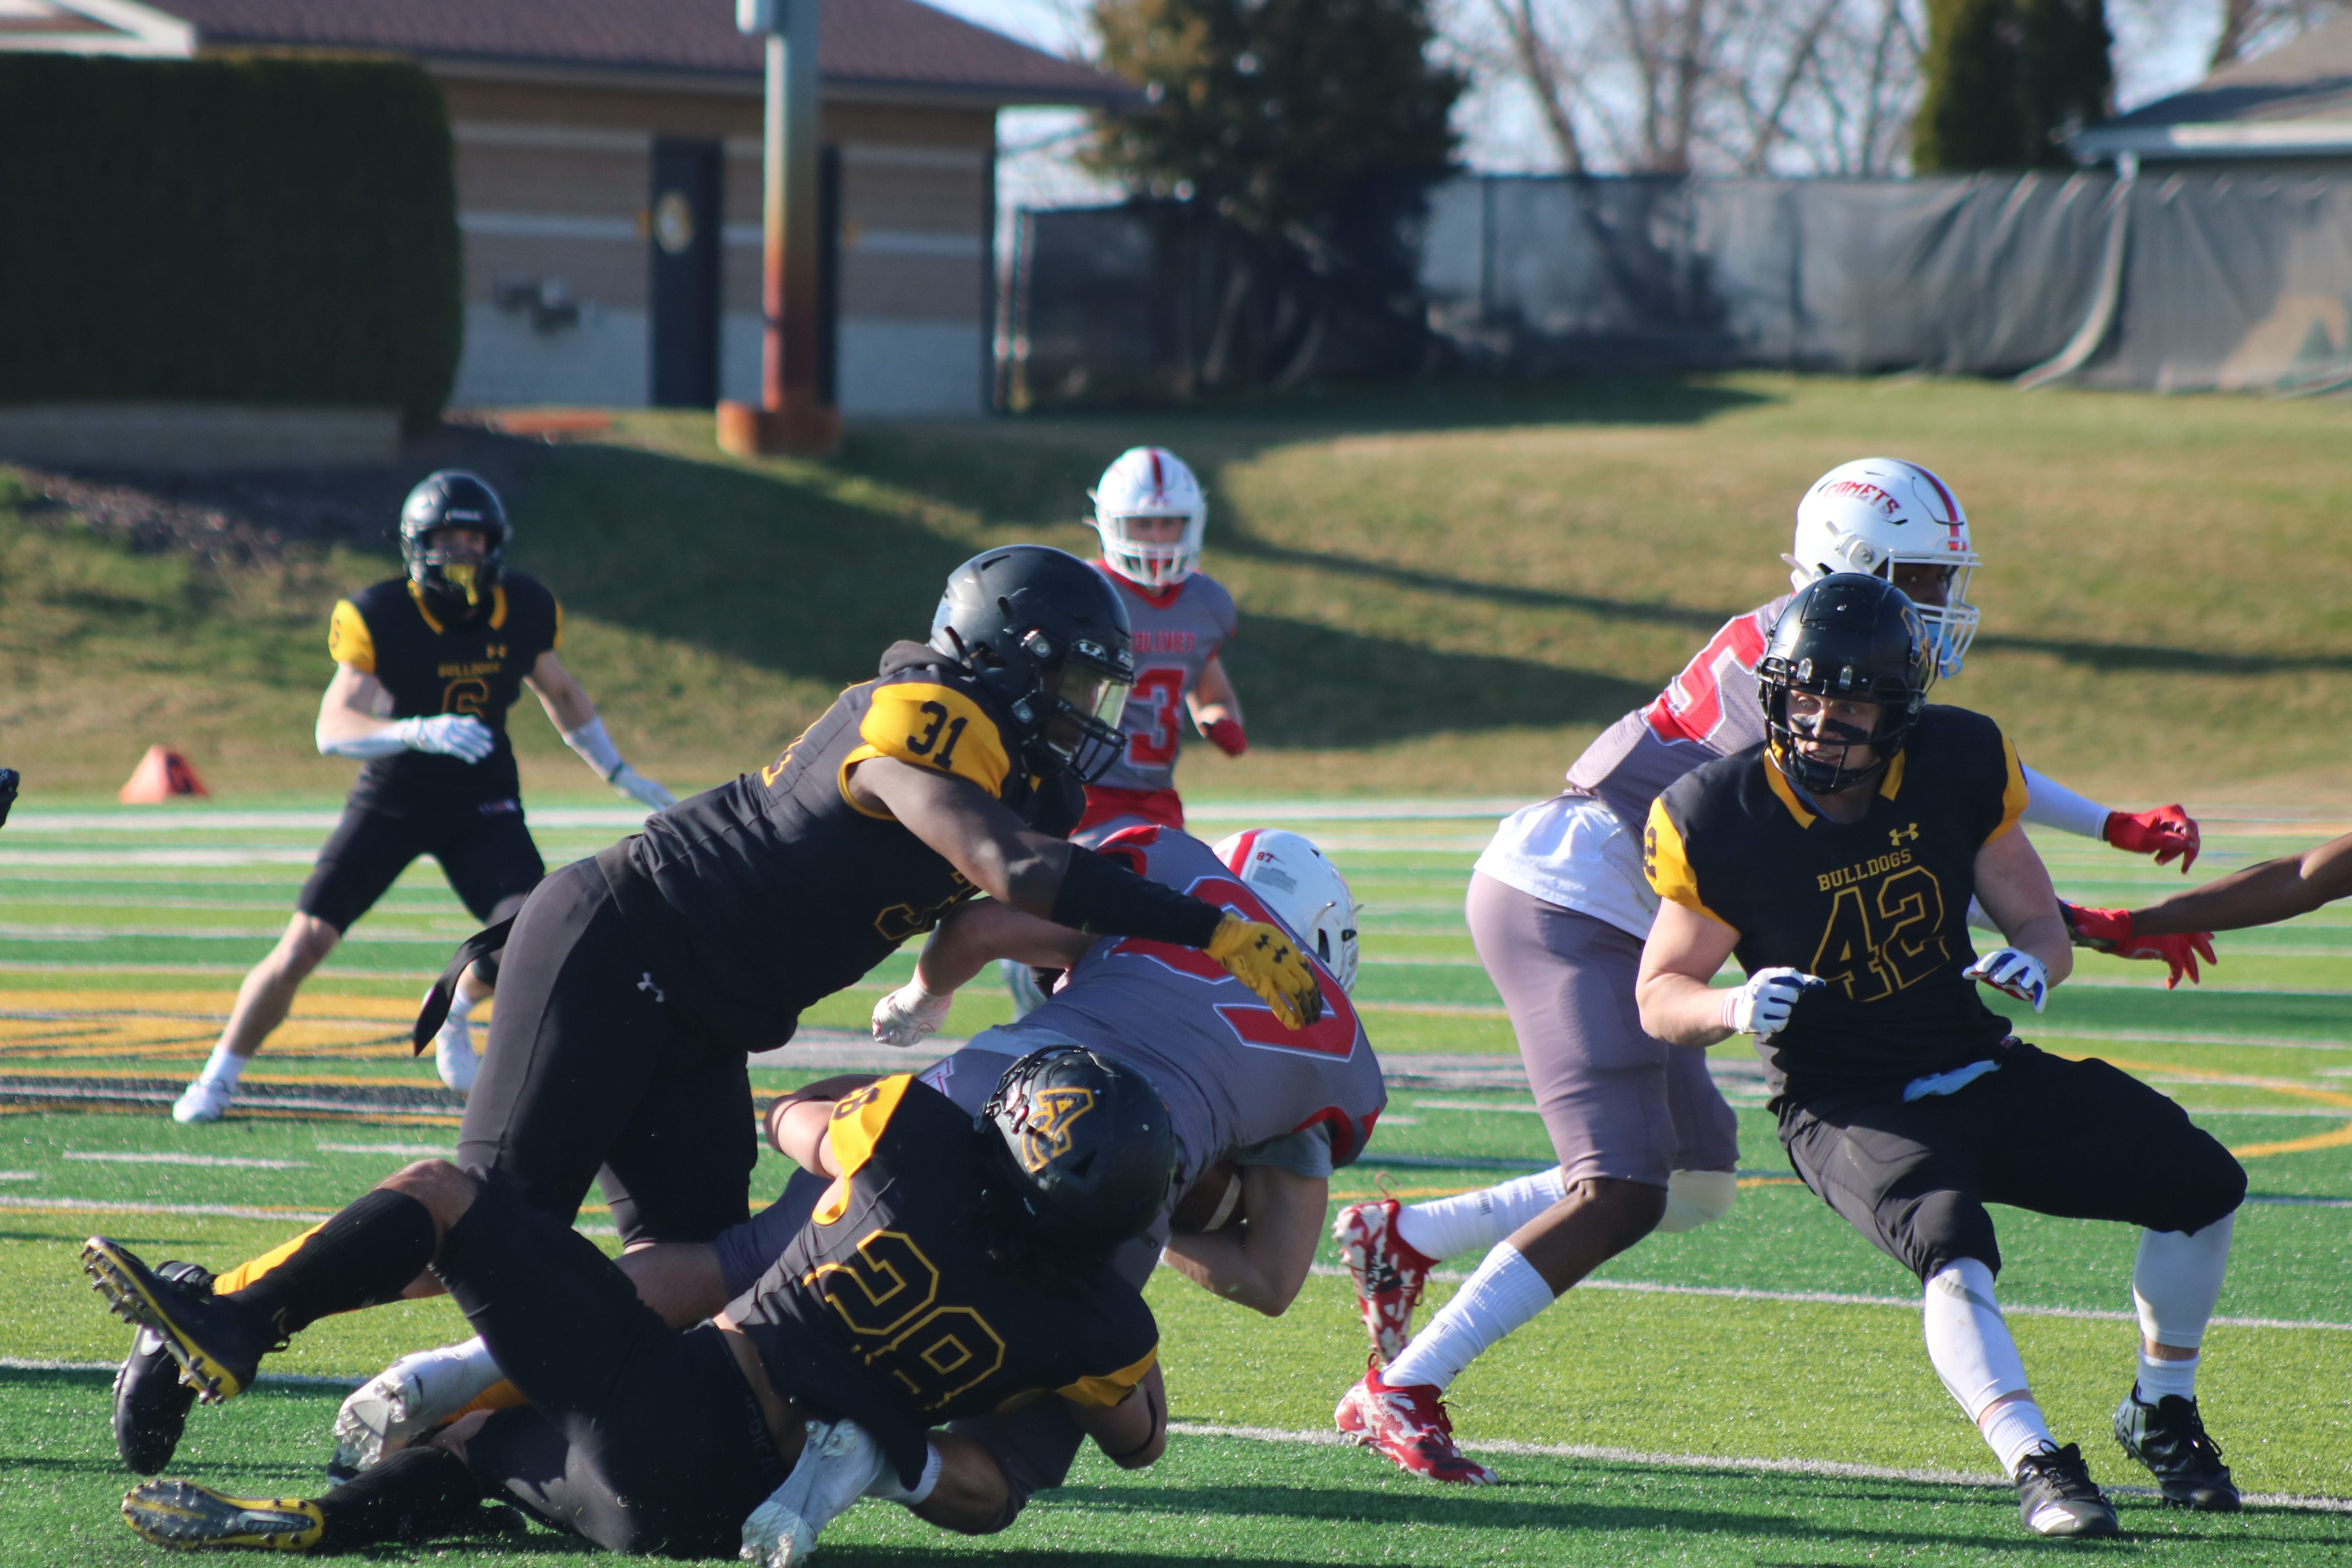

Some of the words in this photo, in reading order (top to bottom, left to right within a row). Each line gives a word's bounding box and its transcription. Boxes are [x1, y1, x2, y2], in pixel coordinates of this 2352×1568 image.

[1823, 480, 1902, 519] COMETS
[906, 700, 968, 770] 31
[1256, 851, 1274, 863] 87
[1817, 848, 1912, 891] BULLDOGS
[1810, 865, 1951, 1002] 42
[802, 1229, 1005, 1411] 28
